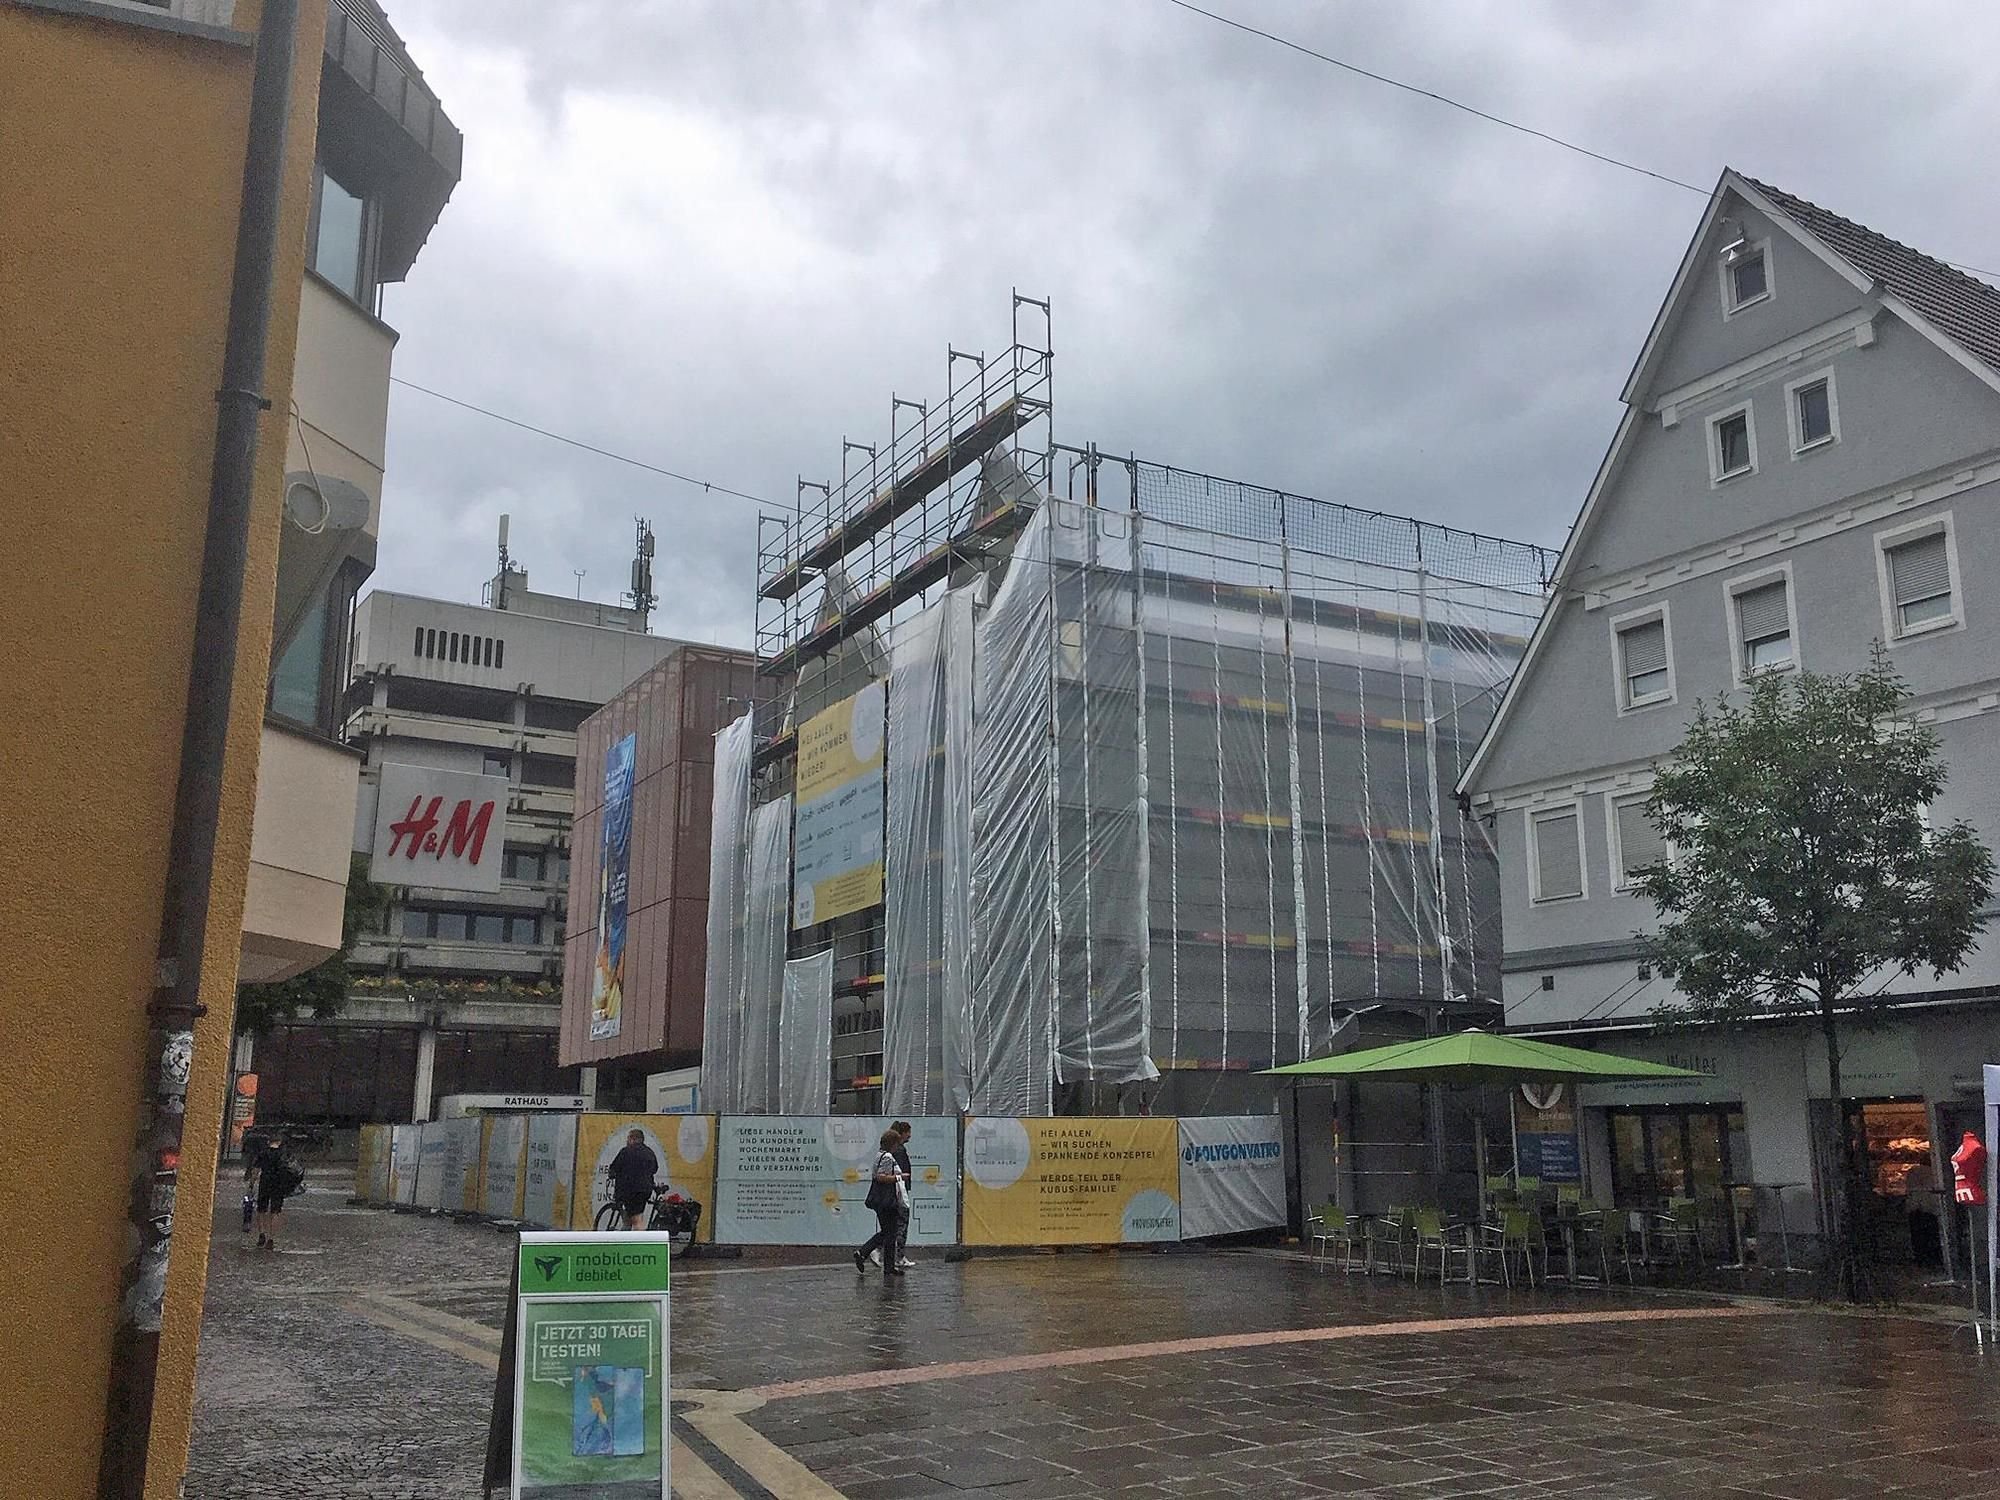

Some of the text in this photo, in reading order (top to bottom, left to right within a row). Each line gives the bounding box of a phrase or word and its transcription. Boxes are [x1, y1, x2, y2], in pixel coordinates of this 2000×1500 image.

[388, 794, 495, 866] H&M
[504, 1096, 549, 1106] RATHAUS
[1061, 1129, 1092, 1138] AALEN
[796, 1137, 817, 1145] BEIM
[1050, 1141, 1069, 1149] WIR
[1072, 1140, 1112, 1148] SUCHEN
[1040, 1151, 1099, 1160] SPANNENDE
[1040, 1173, 1122, 1182] WERDE TEIL DER
[576, 1252, 657, 1266] mobilcom
[575, 1269, 623, 1282] debitel
[540, 1323, 647, 1340] JETZT 30 TAGE
[540, 1343, 600, 1358] TESTEN!
